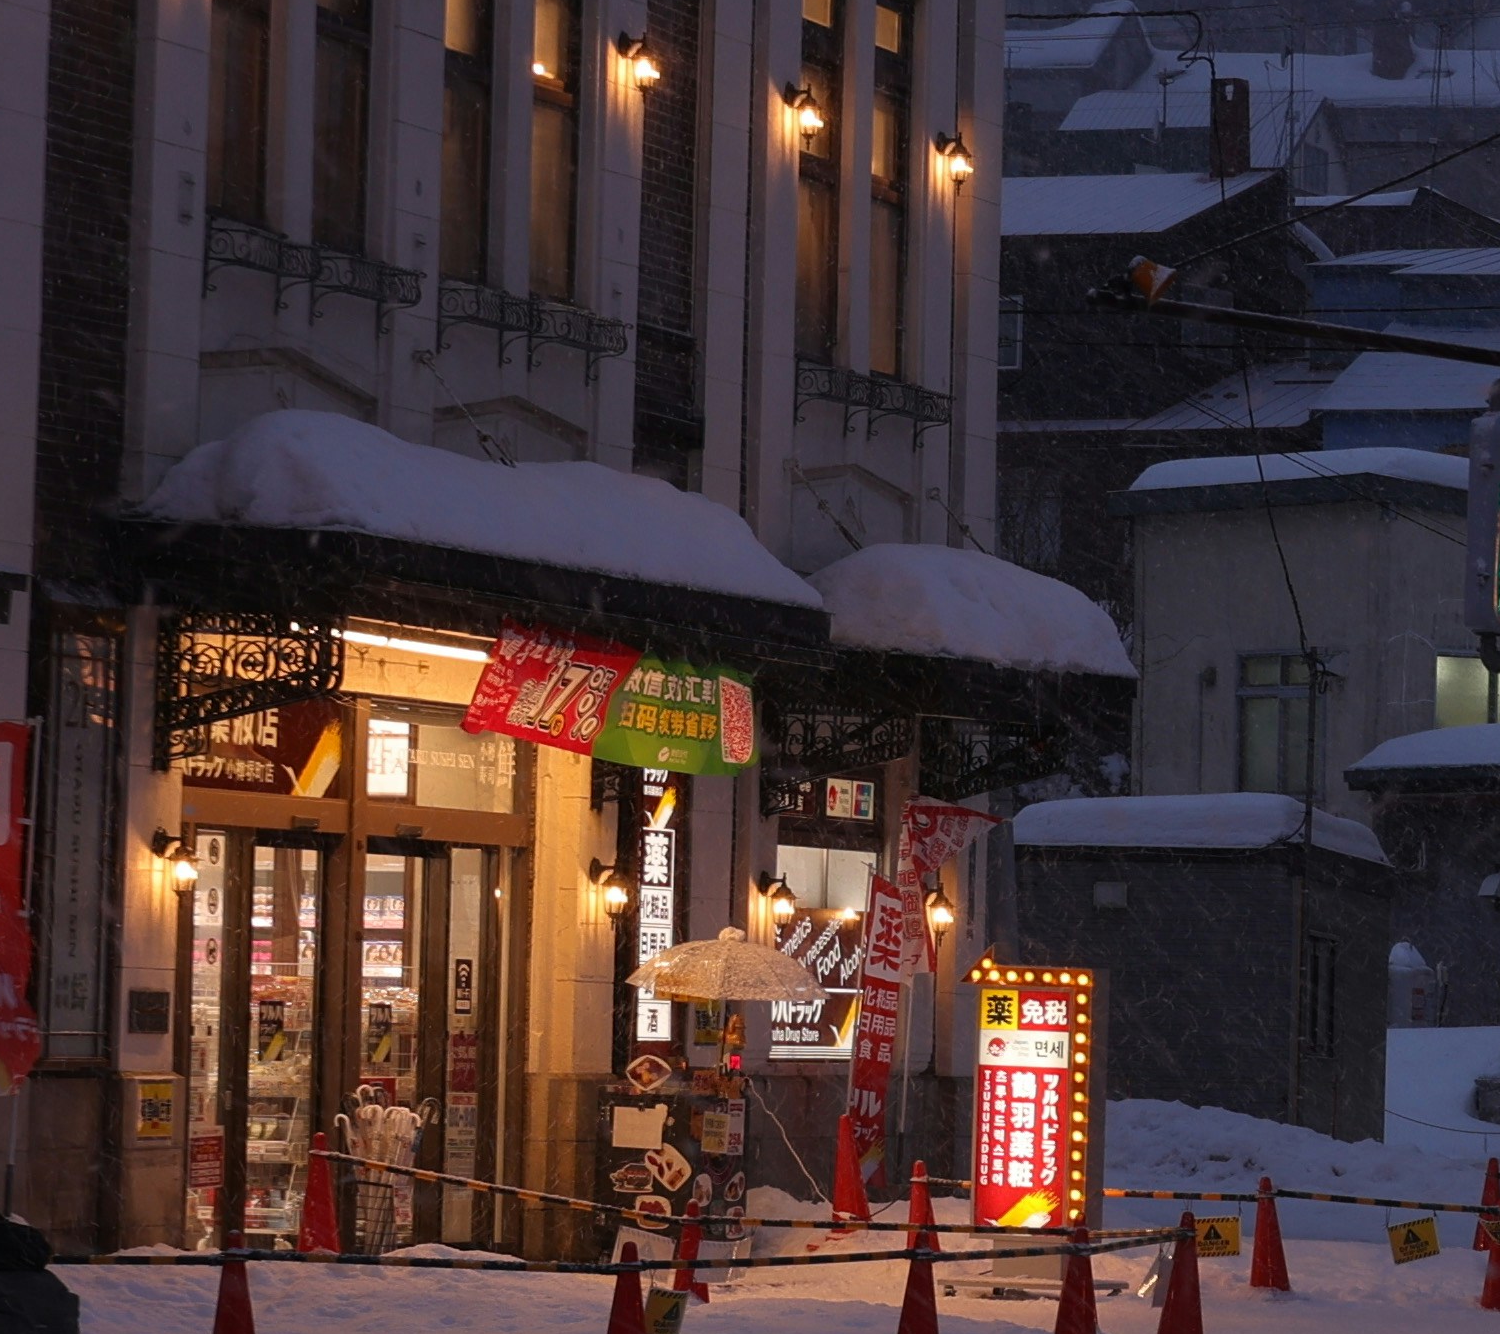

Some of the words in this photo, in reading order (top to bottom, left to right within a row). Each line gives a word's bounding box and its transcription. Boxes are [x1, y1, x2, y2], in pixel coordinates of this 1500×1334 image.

[644, 833, 670, 885] 薬
[870, 904, 902, 971] 薬
[815, 936, 842, 984] Food
[863, 985, 897, 1011] 化粧品
[987, 994, 1013, 1025] 薬
[1020, 999, 1068, 1025] 免税
[785, 1027, 801, 1042] Drug
[802, 1028, 820, 1042] Store
[859, 1011, 896, 1036] 日用品
[859, 1039, 892, 1062] 食品
[1034, 1039, 1064, 1058] 면세
[979, 1070, 992, 1186] TSURUHADRUG
[992, 1070, 1007, 1187] 츠루하드럭스토어
[1007, 1071, 1038, 1188] 鶴羽薬粧
[1039, 1073, 1059, 1186] ツルハドラッグ
